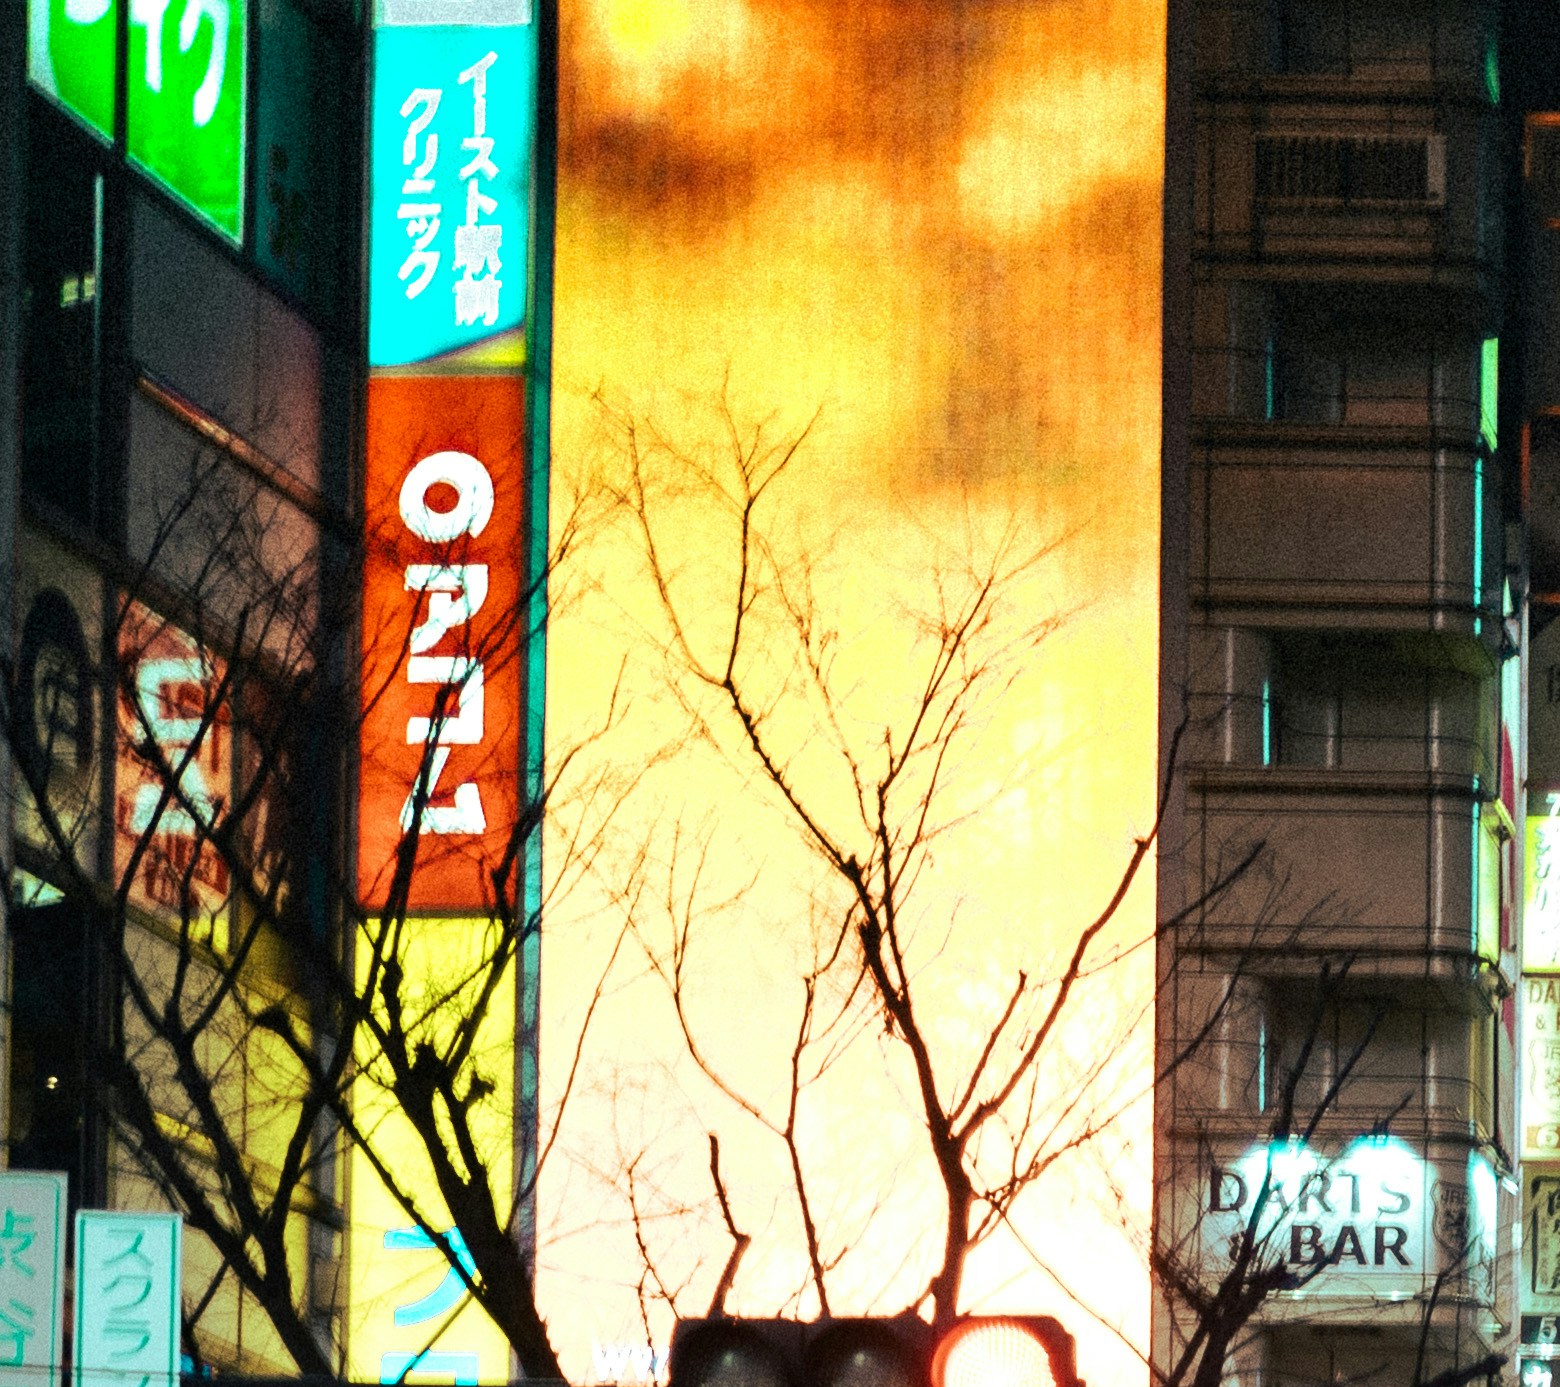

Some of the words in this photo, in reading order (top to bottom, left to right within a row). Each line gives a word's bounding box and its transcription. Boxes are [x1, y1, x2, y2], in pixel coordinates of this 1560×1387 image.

[397, 88, 443, 299] クリニック
[453, 50, 502, 327] イースト駅前
[1535, 1013, 1547, 1031] &
[1209, 1170, 1411, 1213] DARTS
[1288, 1225, 1412, 1266] BAR
